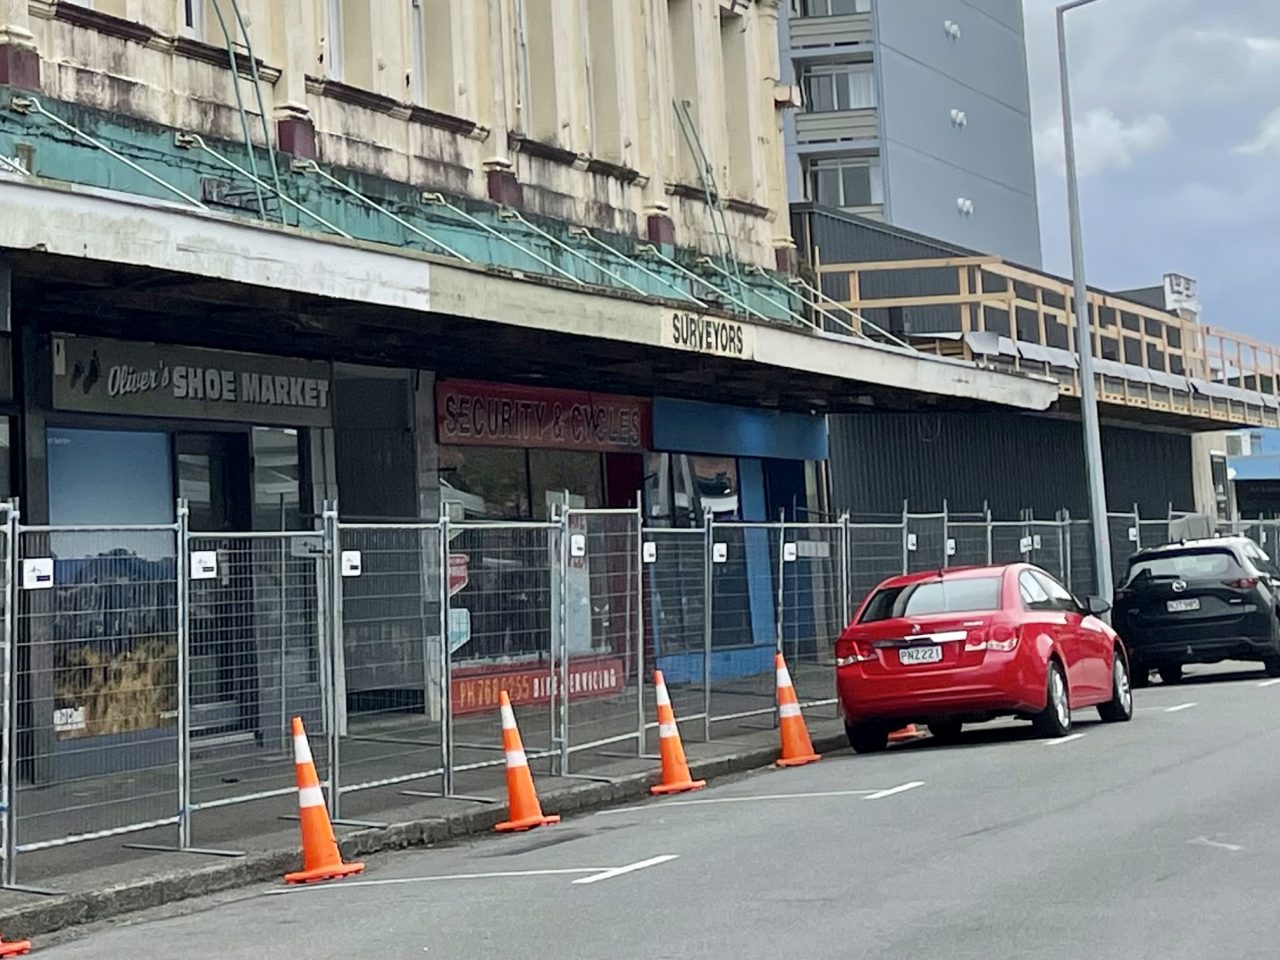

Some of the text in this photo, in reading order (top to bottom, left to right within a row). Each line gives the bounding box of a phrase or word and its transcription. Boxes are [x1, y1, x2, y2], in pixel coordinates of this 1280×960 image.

[672, 312, 744, 355] SURVEYORS
[107, 359, 330, 409] Oliver's SHOE MARKET
[443, 393, 641, 447] SECURITY & CYCLES
[900, 647, 940, 662] PNZ221
[561, 667, 616, 695] ERVICING
